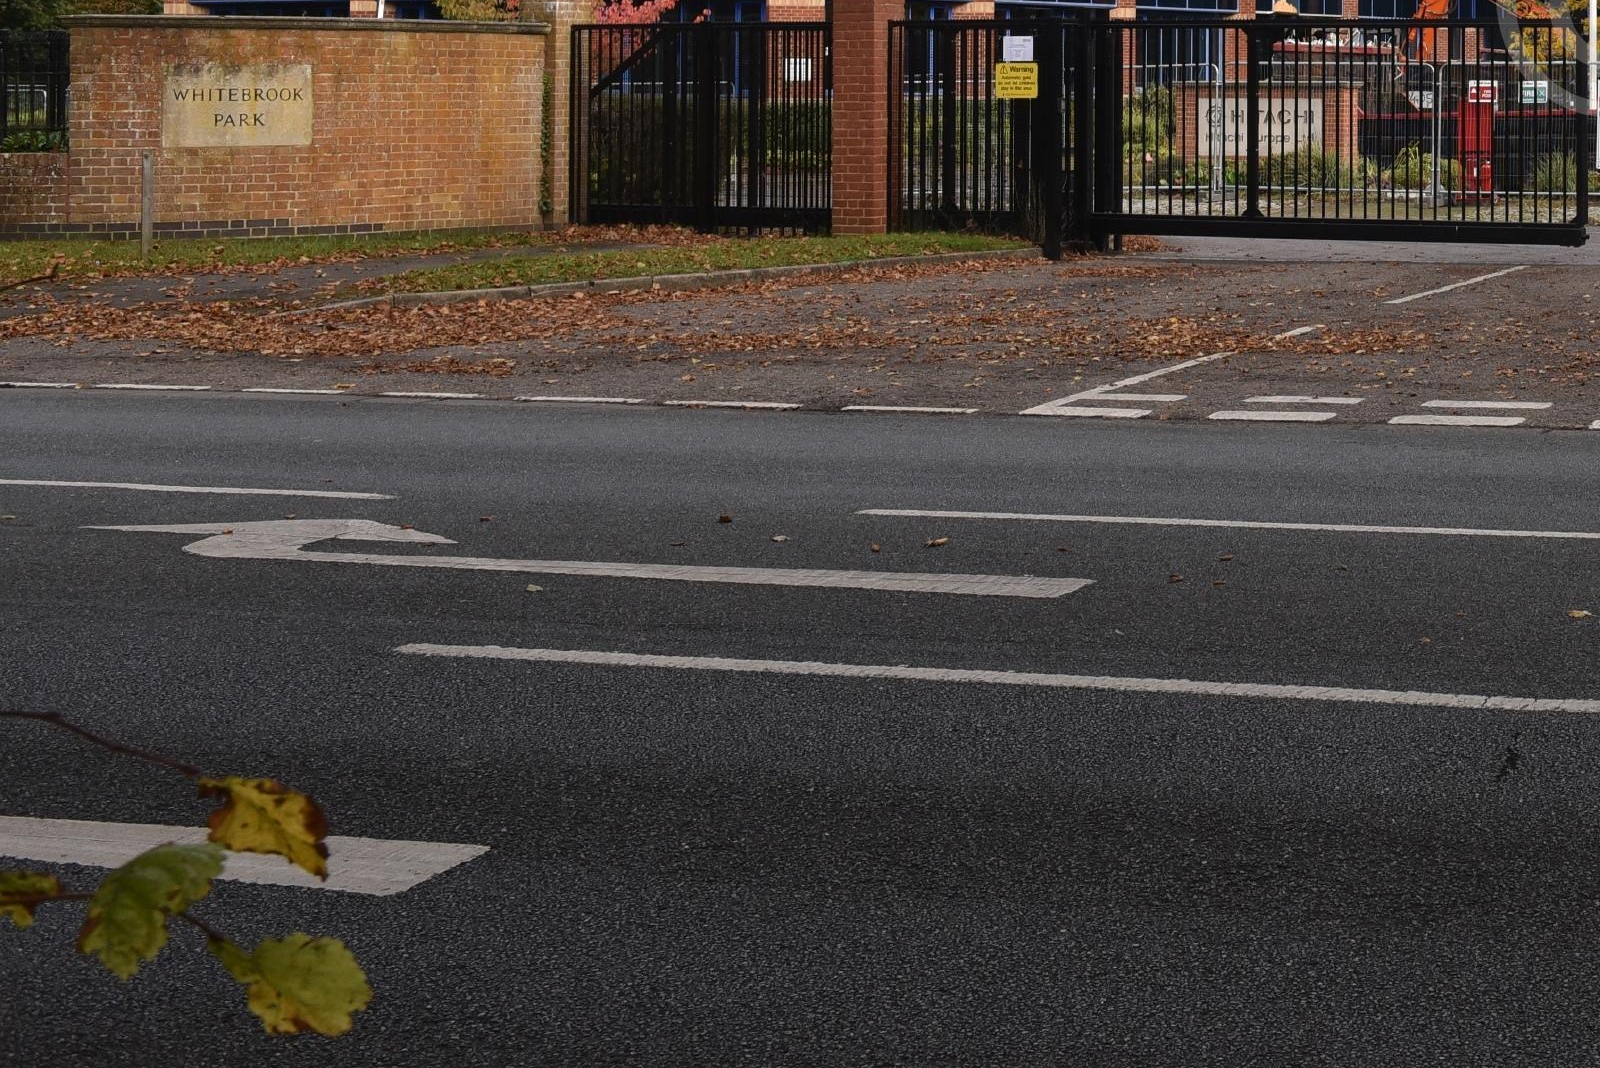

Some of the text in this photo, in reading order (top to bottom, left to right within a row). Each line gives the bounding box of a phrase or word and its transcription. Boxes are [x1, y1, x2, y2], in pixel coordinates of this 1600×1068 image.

[1009, 66, 1034, 74] Warning
[173, 87, 304, 102] WHITEBROOK
[213, 113, 266, 127] PARK
